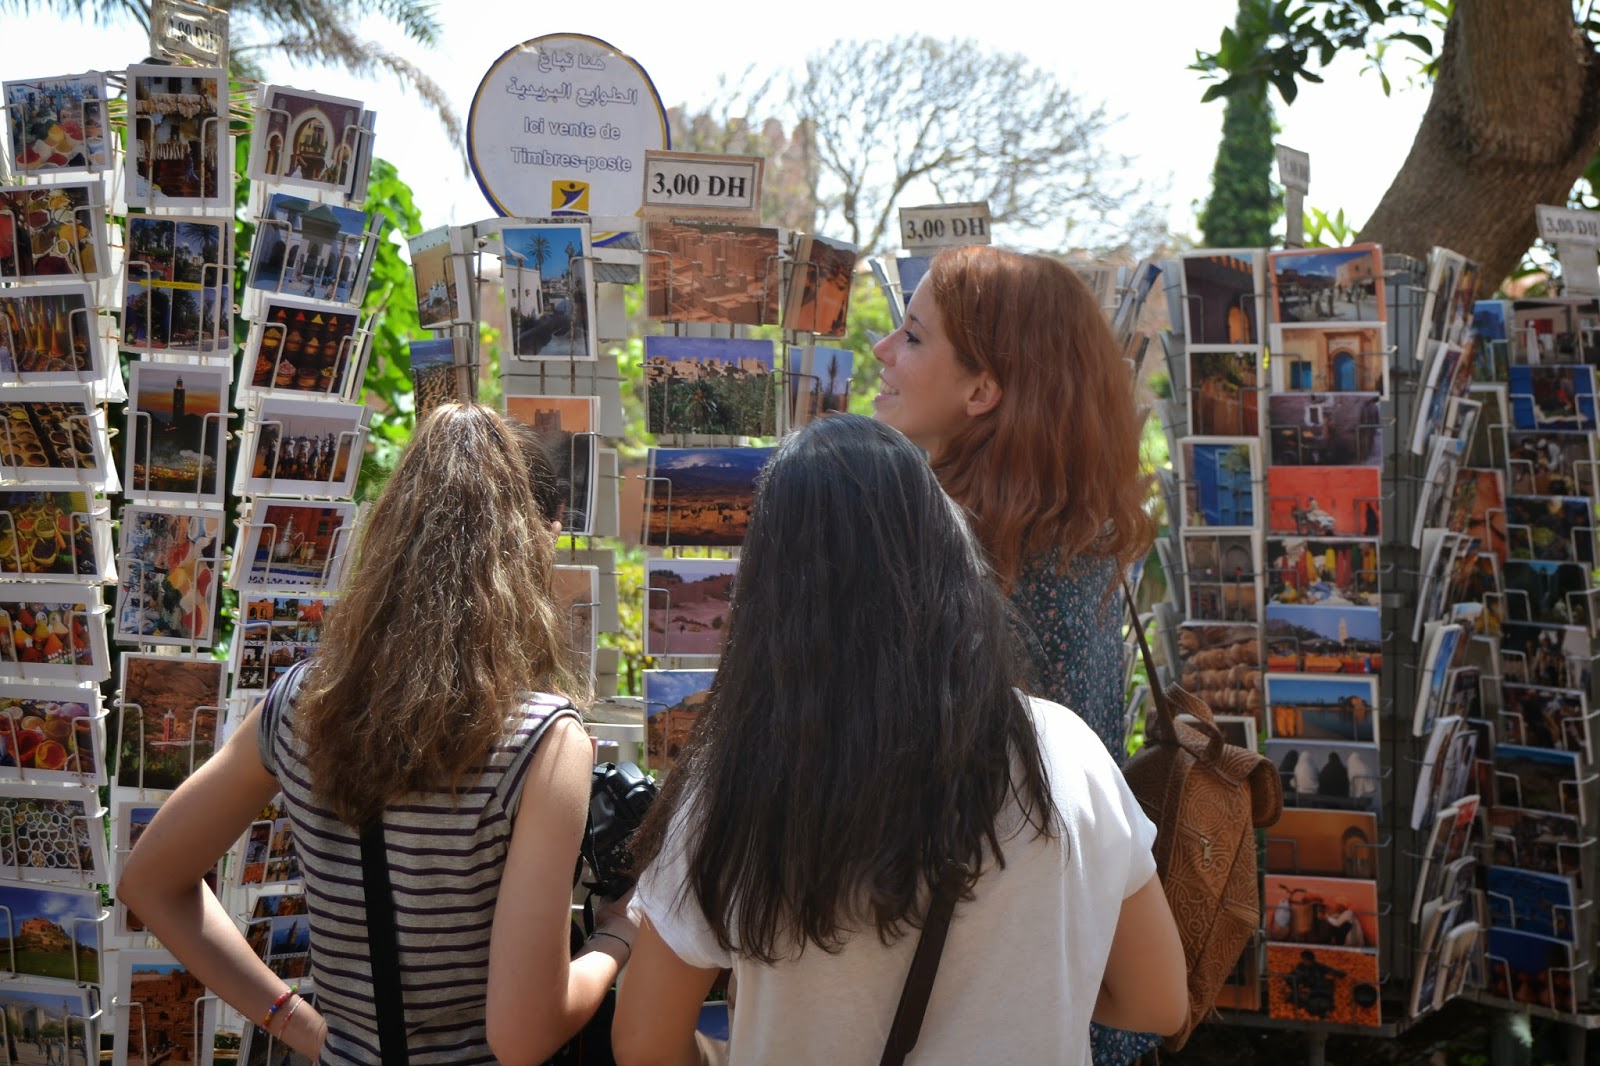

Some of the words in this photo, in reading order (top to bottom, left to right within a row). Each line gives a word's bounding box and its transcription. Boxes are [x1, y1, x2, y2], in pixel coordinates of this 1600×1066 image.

[577, 53, 606, 71] هنا
[506, 76, 572, 103] البريدية
[575, 85, 638, 108] الطوابع
[524, 116, 545, 134] Ici
[549, 121, 596, 138] vente
[600, 123, 621, 140] de
[511, 147, 632, 173] Timbres-poste
[652, 172, 700, 198] 3,00
[707, 175, 747, 198] DH
[906, 219, 945, 242] 3,00
[951, 217, 986, 237] DH
